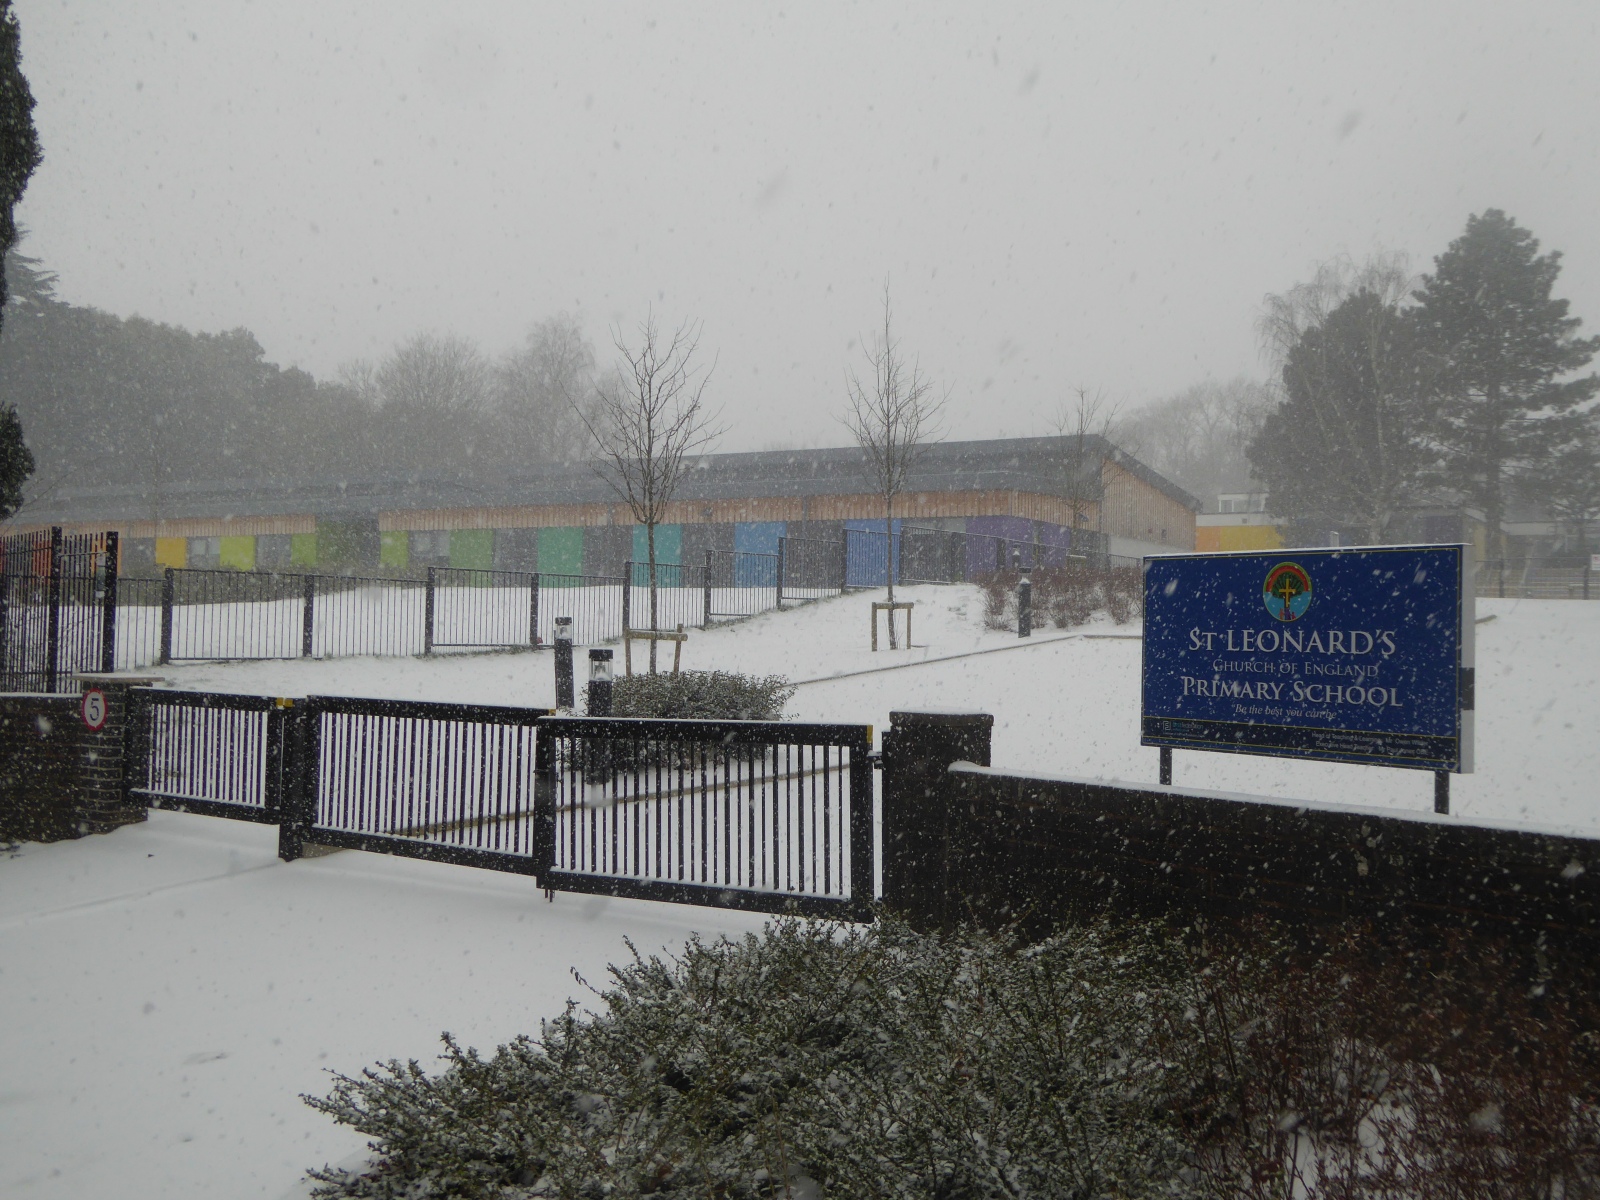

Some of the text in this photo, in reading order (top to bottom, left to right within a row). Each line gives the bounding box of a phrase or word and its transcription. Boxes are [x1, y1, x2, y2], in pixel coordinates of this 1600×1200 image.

[1226, 629, 1397, 655] LEONARD'S
[1181, 676, 1404, 707] PRIMARY SCHOOL
[89, 698, 99, 721] 5
[1249, 704, 1263, 715] the
[1265, 705, 1283, 716] best
[1286, 709, 1303, 719] you
